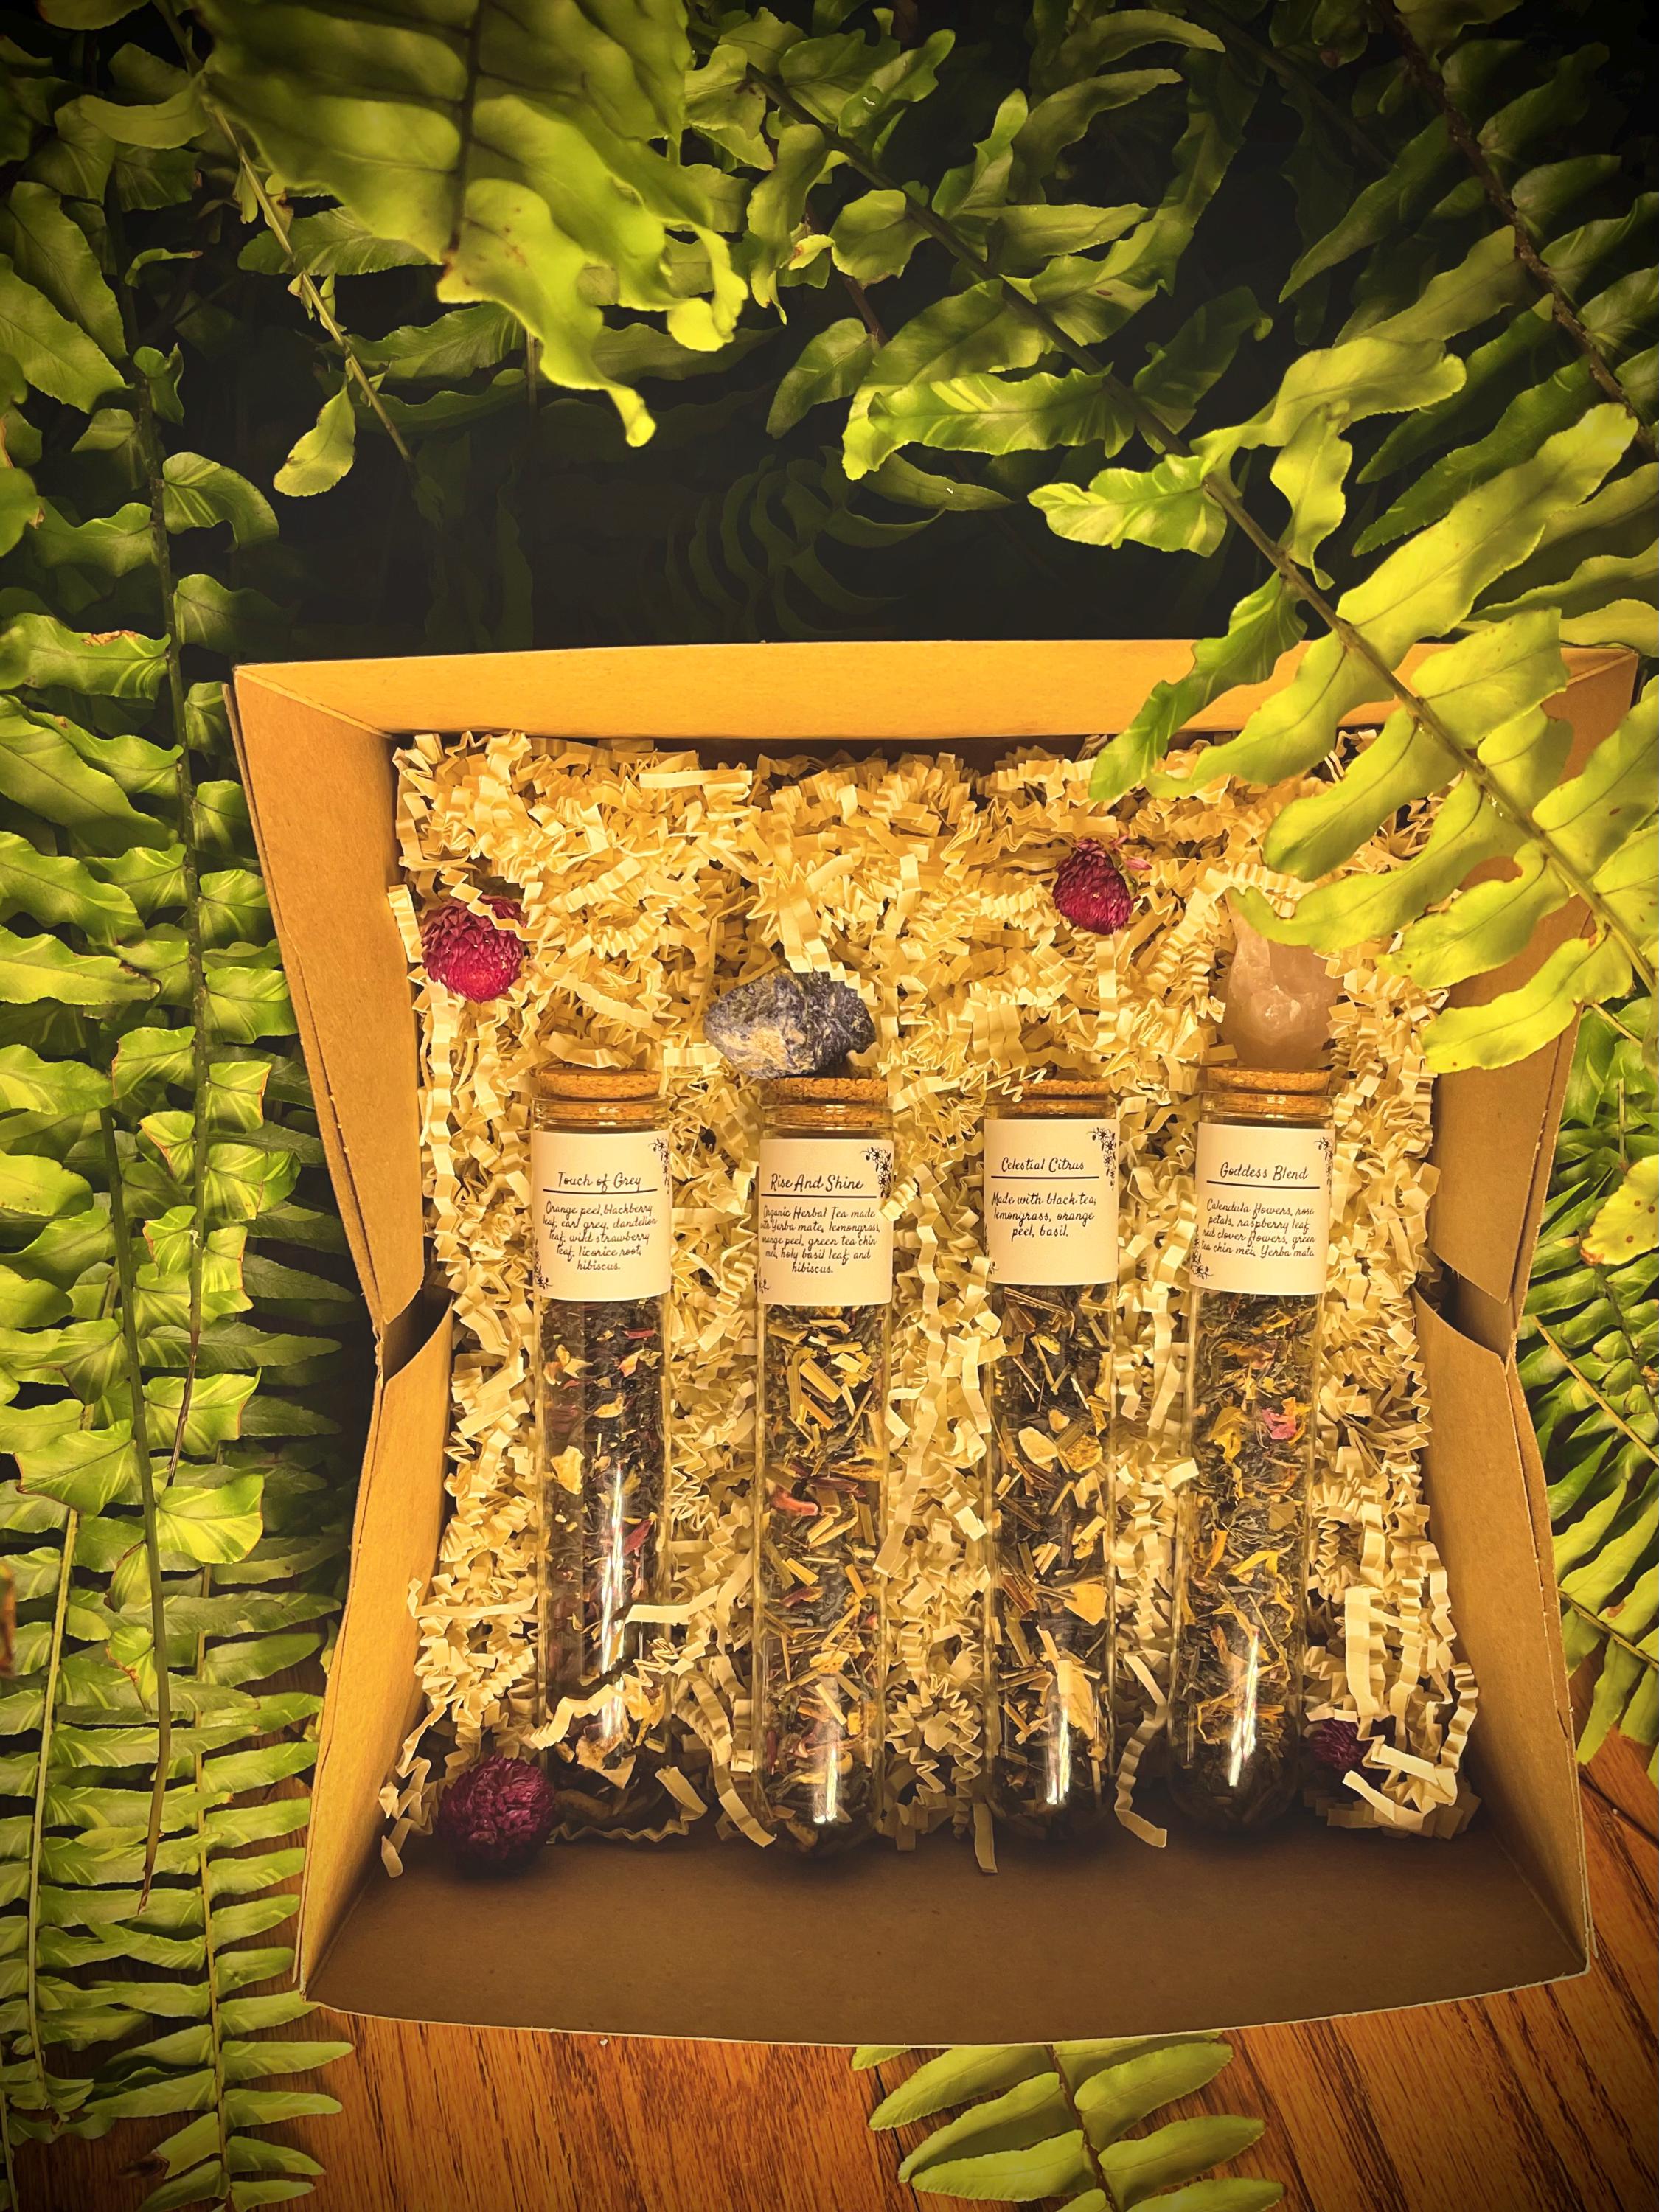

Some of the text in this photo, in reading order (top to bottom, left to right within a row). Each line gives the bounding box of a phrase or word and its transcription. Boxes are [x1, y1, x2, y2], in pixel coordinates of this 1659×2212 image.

[1001, 1157, 1084, 1172] Celestial Citrus
[1220, 1162, 1308, 1181] Goddess Blend
[558, 1172, 641, 1193] Touch of Grey
[771, 1173, 863, 1192] Rise And Shine
[992, 1192, 1015, 1206] Made
[1018, 1192, 1043, 1205] with
[1047, 1192, 1077, 1205] black
[1207, 1198, 1251, 1213] Calendula
[546, 1200, 578, 1220] Orange
[604, 1203, 653, 1216] blackberry
[764, 1205, 875, 1222] Organic Herbal Tea made
[561, 1219, 580, 1228] earl
[613, 1217, 658, 1228] dandelion
[1057, 1212, 1094, 1228] orange
[1237, 1218, 1289, 1234] raspberry
[569, 1232, 594, 1242] wild
[596, 1233, 650, 1245] strawberry
[808, 1238, 838, 1251] green
[841, 1236, 856, 1245] tea
[858, 1235, 877, 1246] chin
[1203, 1229, 1215, 1237] red
[1217, 1228, 1246, 1241] clover
[1292, 1236, 1316, 1250] green
[578, 1245, 618, 1256] licorice
[781, 1248, 799, 1263] holy
[802, 1249, 825, 1259] basil
[853, 1249, 871, 1259] and
[1201, 1240, 1211, 1251] tea
[1214, 1242, 1233, 1253] chin
[1260, 1245, 1291, 1259] Yerba
